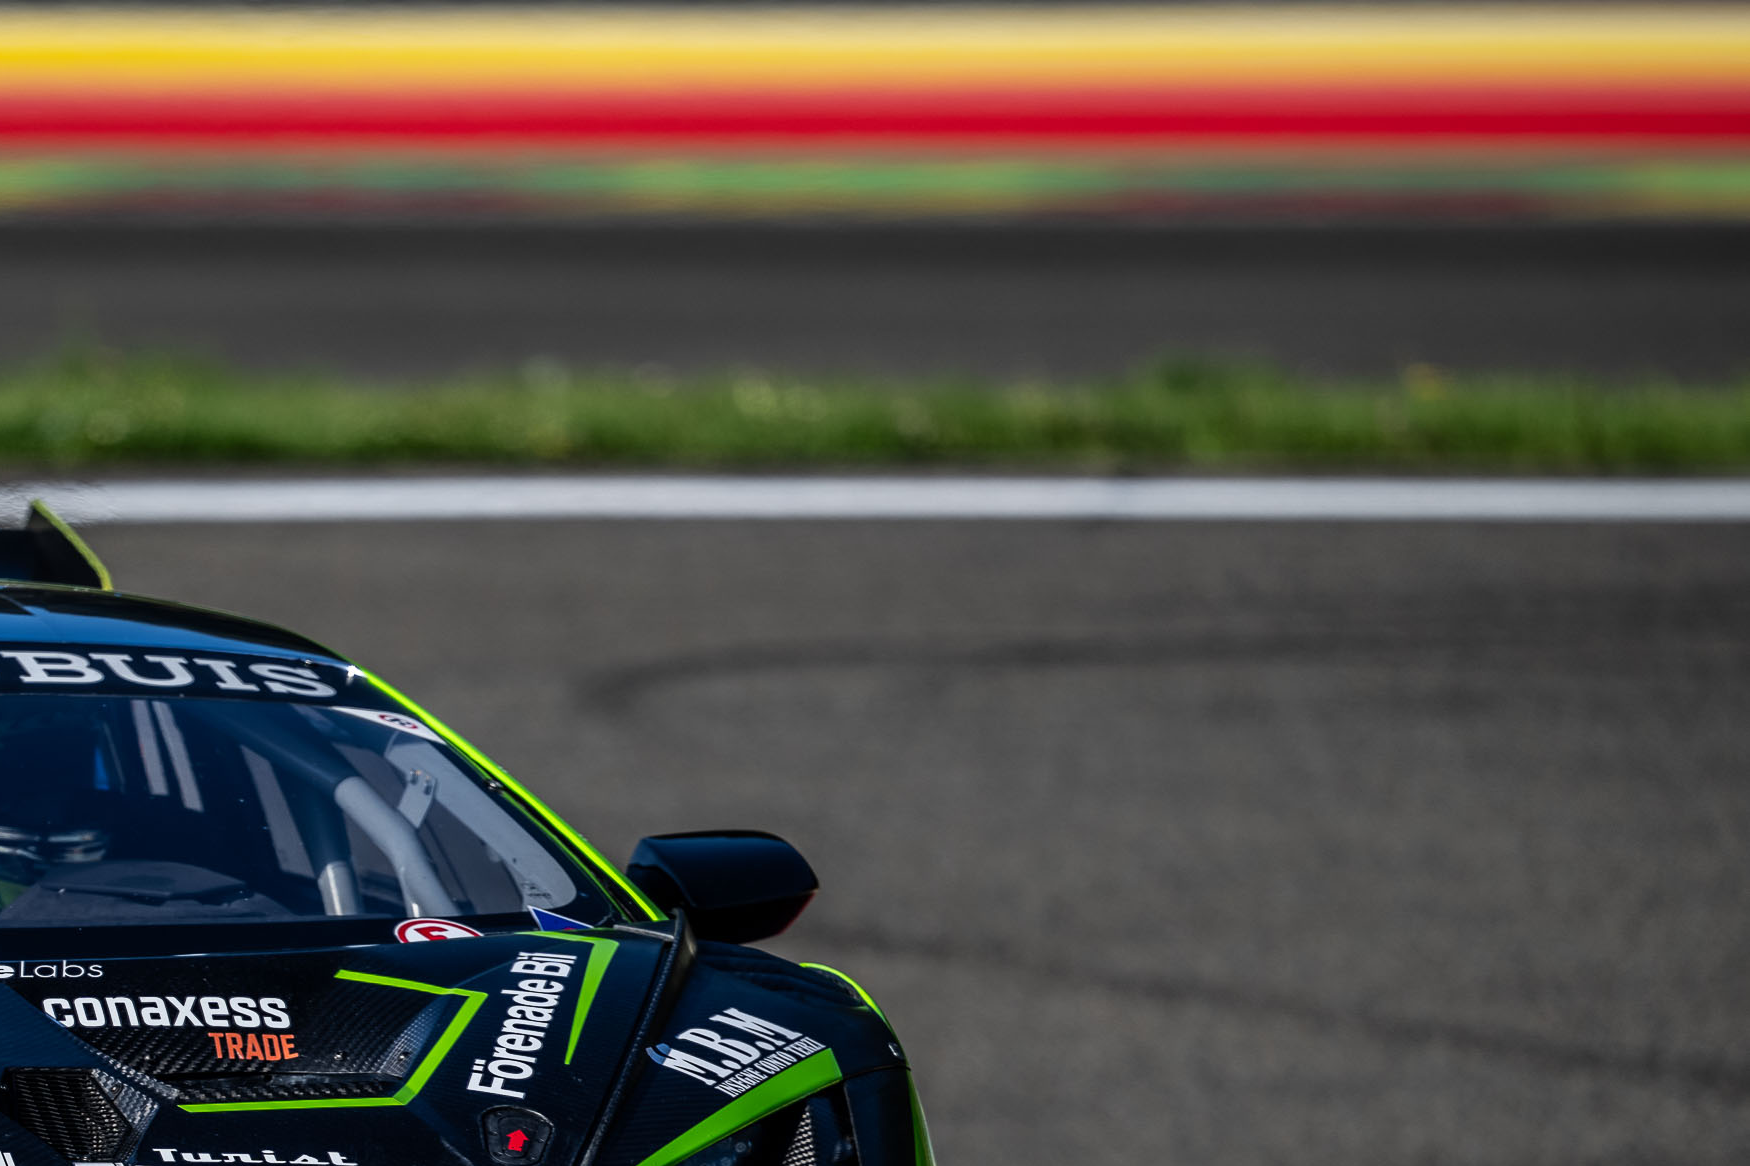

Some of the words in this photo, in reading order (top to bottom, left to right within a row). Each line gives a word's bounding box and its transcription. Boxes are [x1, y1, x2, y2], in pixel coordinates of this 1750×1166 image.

[510, 951, 578, 978] Bil
[42, 996, 292, 1030] conaxess
[208, 1031, 299, 1062] TRADE
[466, 979, 565, 1100] Förenade
[714, 1066, 769, 1098] INSEGNE
[753, 1050, 798, 1075] CONTO
[783, 1036, 827, 1060] TERZI
